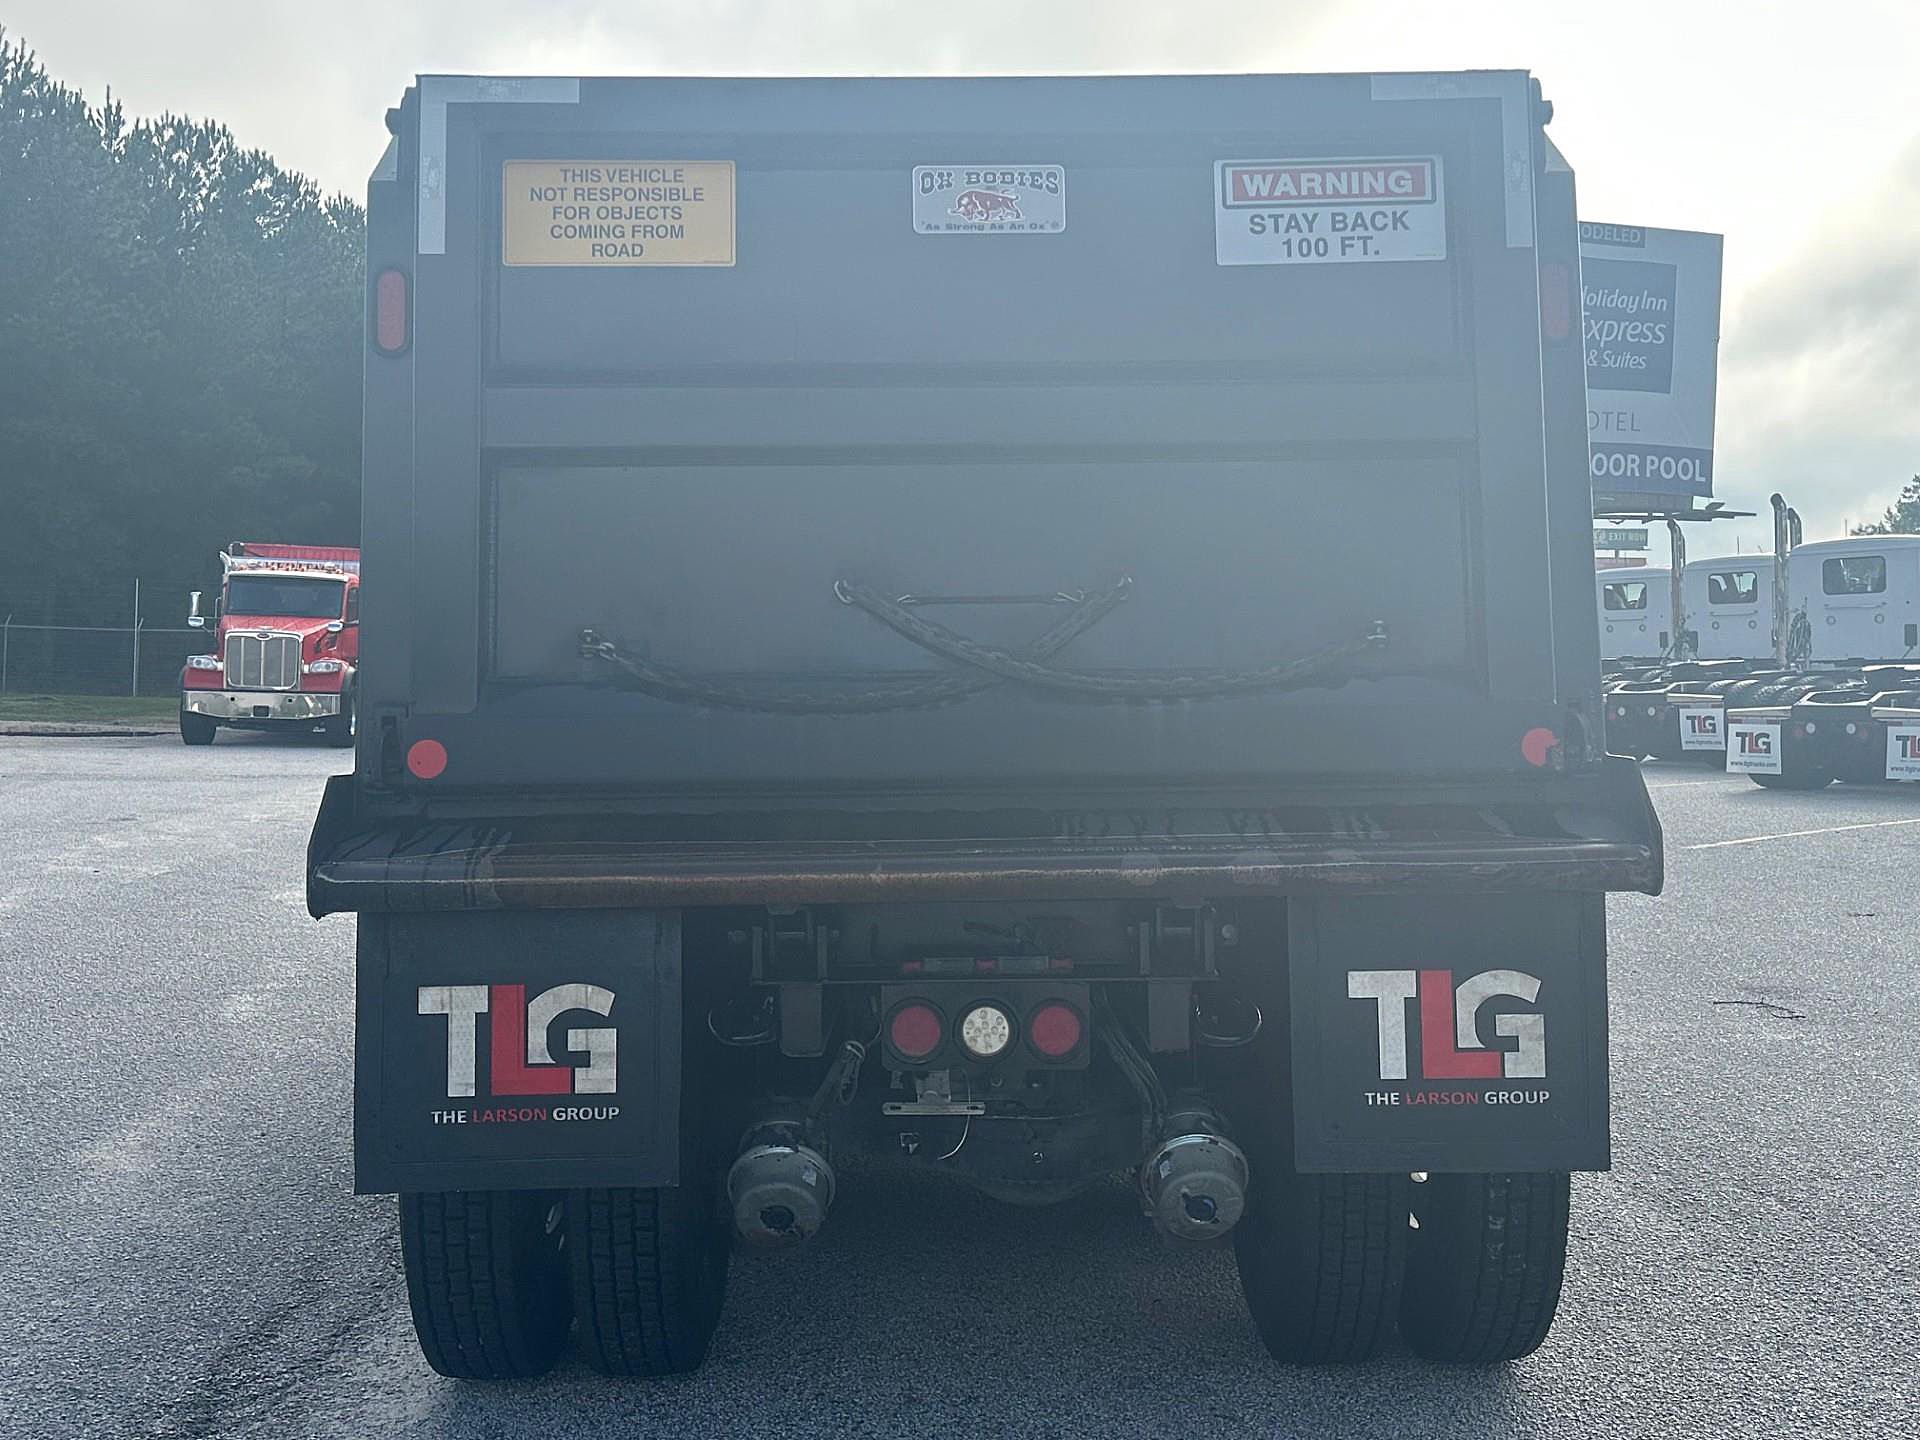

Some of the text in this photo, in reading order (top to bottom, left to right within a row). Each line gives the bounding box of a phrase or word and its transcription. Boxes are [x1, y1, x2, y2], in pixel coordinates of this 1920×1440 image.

[560, 168, 685, 183] THIS VEHICLE
[965, 171, 1059, 194] BODIES
[1241, 170, 1413, 197] WARNING
[530, 187, 705, 202] NOT RESPONSIBLE
[552, 206, 682, 220] FOR OBJECTS
[1249, 210, 1410, 234] STAY BACK
[550, 224, 685, 239] COMING FROM
[945, 222, 985, 232] Strong
[989, 222, 1005, 231] As
[1009, 222, 1025, 230] An
[1581, 225, 1641, 243] ODELED
[591, 243, 644, 258] ROAD
[1281, 235, 1380, 258] 100 FT.
[1641, 289, 1668, 311] Inn
[1587, 349, 1647, 370] & Suites
[1591, 452, 1706, 482] OOR POOL
[1686, 714, 1717, 734] TLG
[1735, 731, 1772, 754] TLG
[1895, 735, 1920, 758] TL
[1347, 969, 1547, 1080] TLG
[417, 983, 618, 1098] TLG
[1364, 1090, 1551, 1106] THE LARSON GROUP
[431, 1106, 620, 1125] THE LARSON GROUP
